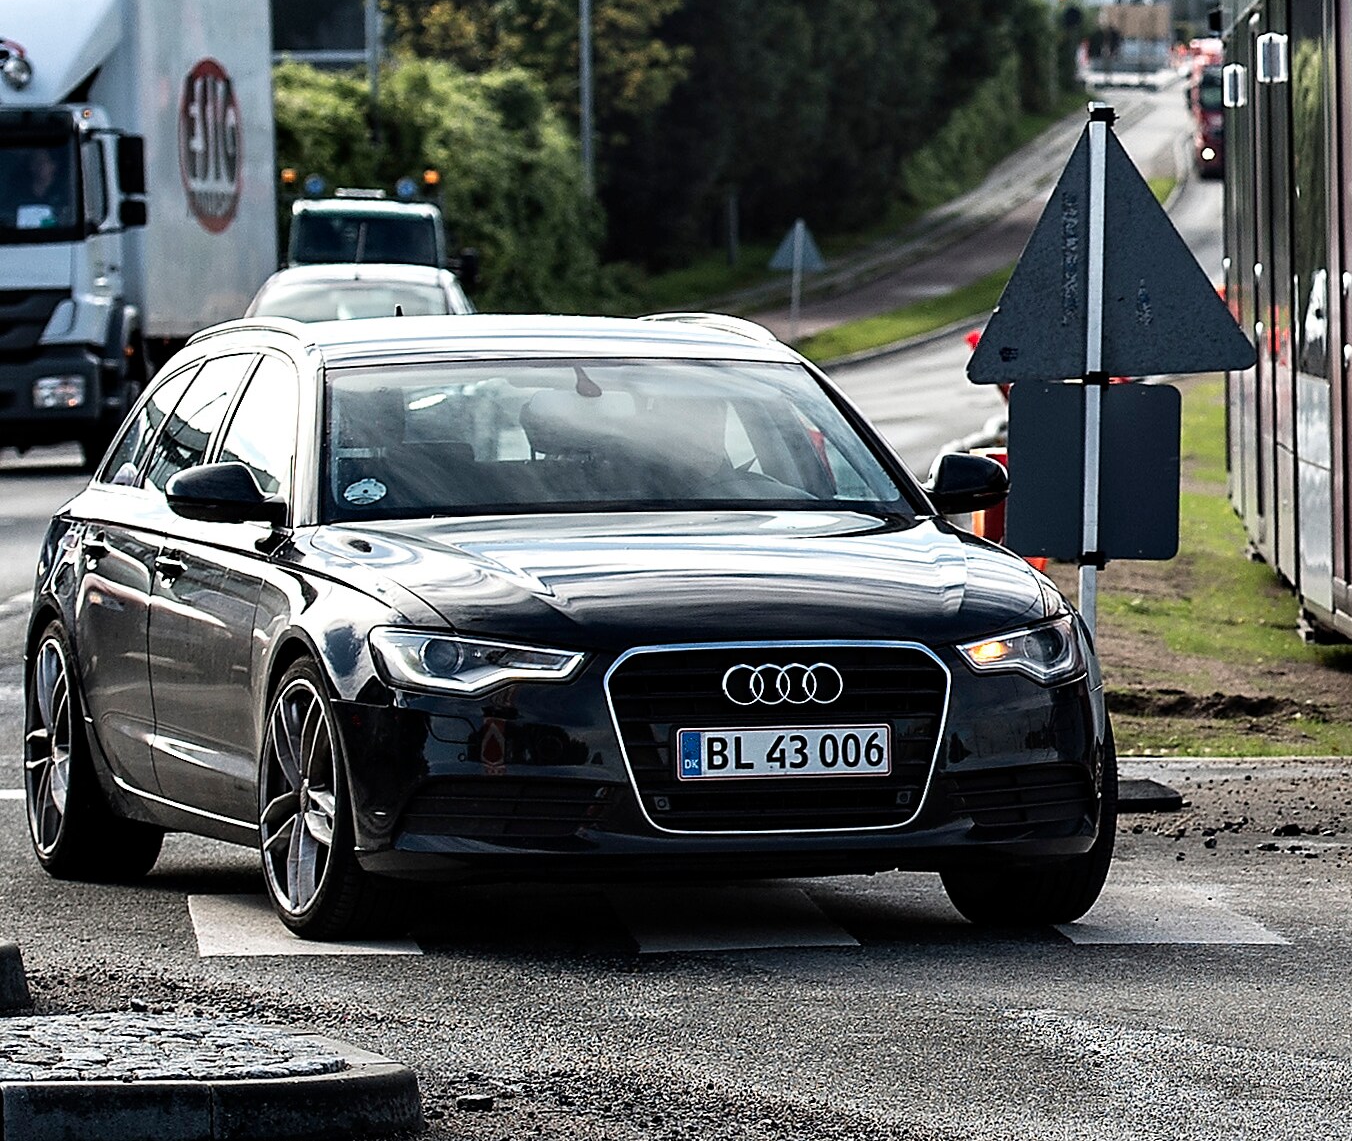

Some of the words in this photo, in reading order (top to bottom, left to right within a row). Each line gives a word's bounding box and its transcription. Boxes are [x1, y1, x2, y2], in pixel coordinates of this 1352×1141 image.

[684, 758, 700, 770] DK
[706, 735, 755, 771] BL
[765, 734, 809, 769] 43
[818, 731, 884, 768] 006
